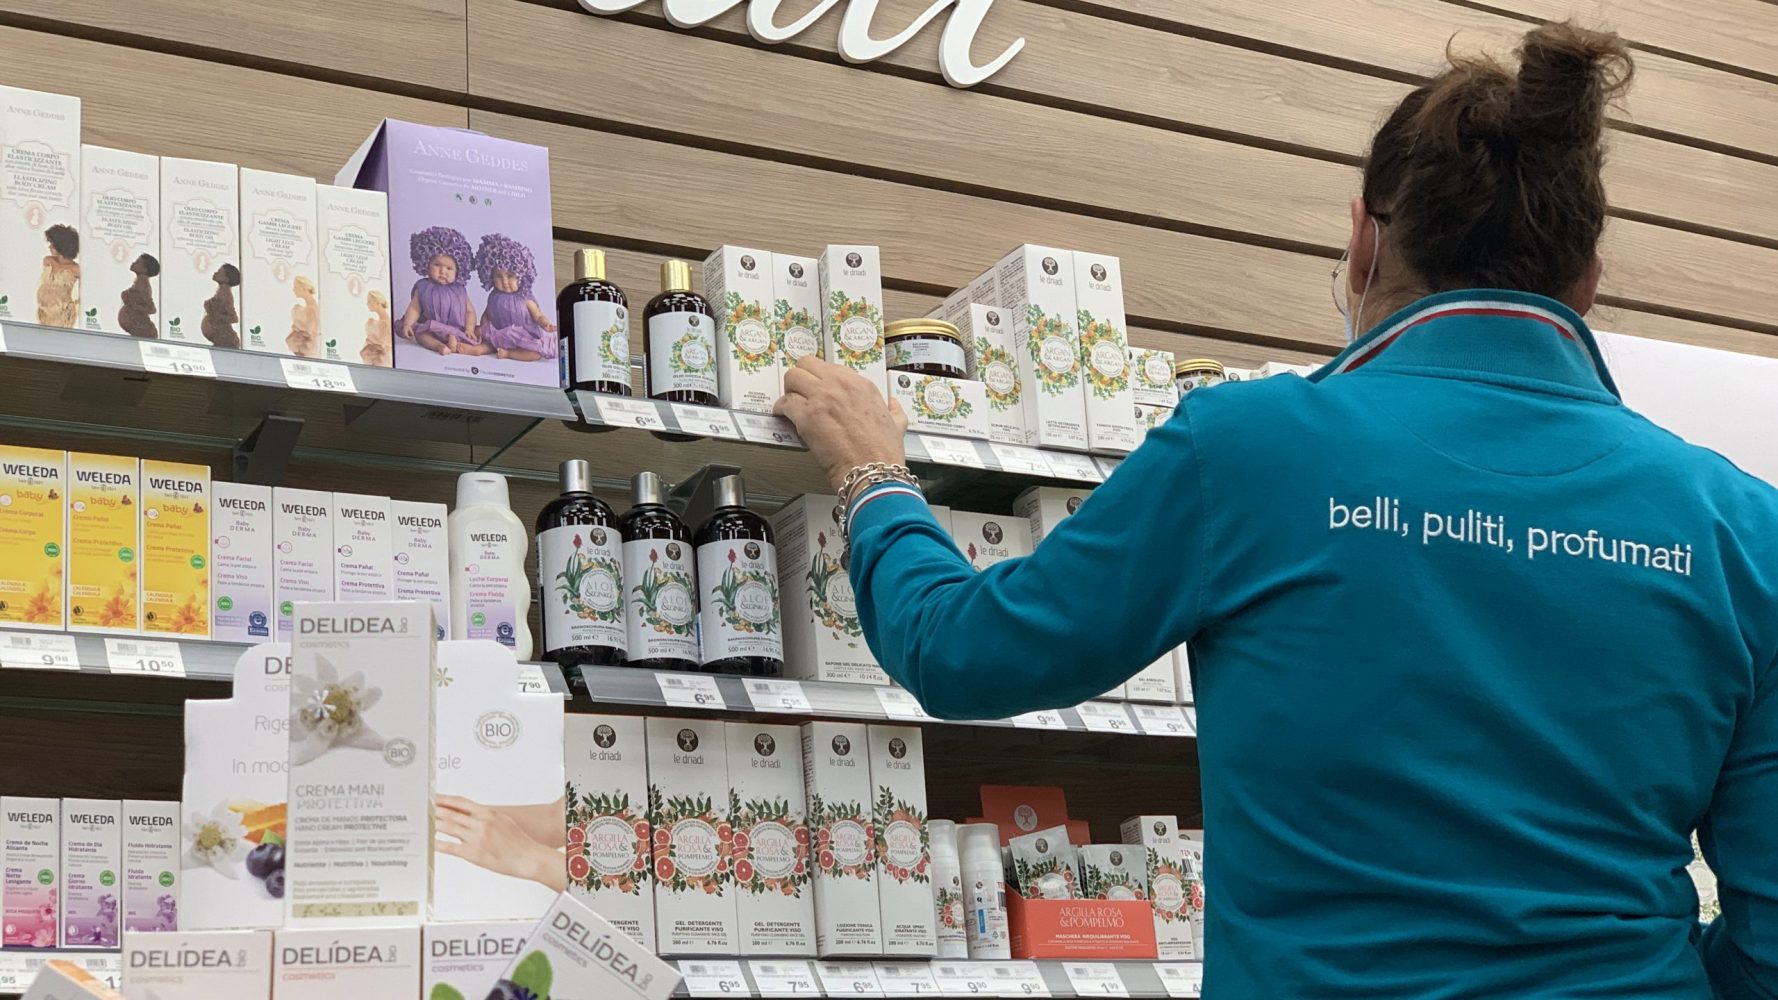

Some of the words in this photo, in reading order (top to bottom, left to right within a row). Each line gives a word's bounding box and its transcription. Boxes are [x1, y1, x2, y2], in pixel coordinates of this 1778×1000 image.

[412, 140, 462, 160] ANNE
[465, 150, 529, 172] GEDDES
[3, 463, 59, 480] WELEDA
[76, 470, 131, 485] WELEDA
[150, 477, 203, 494] WELEDA
[219, 498, 266, 512] WELEDA
[282, 503, 327, 517] WELEDA
[341, 508, 386, 521] WELEDA
[398, 516, 442, 528] WELEDA
[230, 525, 255, 533] DERMA
[292, 530, 317, 538] DERMA
[352, 534, 376, 542] DERMA
[470, 533, 508, 543] WELEDA
[1329, 496, 1409, 537] belli,
[1422, 509, 1514, 553] puliti,
[1527, 526, 1692, 576] profumati
[980, 545, 987, 556] le
[299, 618, 395, 634] DELIDEA
[485, 723, 512, 737] BIO
[390, 748, 410, 758] BIO
[590, 749, 598, 761] le
[599, 750, 622, 761] driadi
[674, 753, 682, 764] le
[682, 754, 704, 765] driadi
[752, 759, 759, 768] le
[760, 760, 781, 769] driadi
[829, 757, 836, 767] le
[295, 785, 345, 798] CREMA
[349, 784, 385, 796] MANI
[296, 797, 384, 811] PROTETTIVA
[7, 812, 53, 824] WELEDA
[70, 813, 115, 825] WELEDA
[129, 815, 174, 827] WELEDA
[344, 823, 387, 831] PROTECTIVE
[592, 833, 628, 843] ARGILLA
[677, 837, 711, 846] ARGILLA
[755, 839, 789, 848] ARGILLA
[592, 842, 618, 852] ROSA
[677, 845, 702, 854] ROSA
[755, 847, 780, 855] ROSA
[592, 851, 630, 860] POMPELMO
[677, 853, 713, 861] POMPELMO
[755, 855, 791, 863] POMPELMO
[1059, 907, 1095, 918] ARGILLA
[1097, 907, 1123, 918] ROSA
[542, 931, 588, 969] cosmetics
[432, 963, 484, 973] cosmetics
[282, 971, 336, 982] cosmetics
